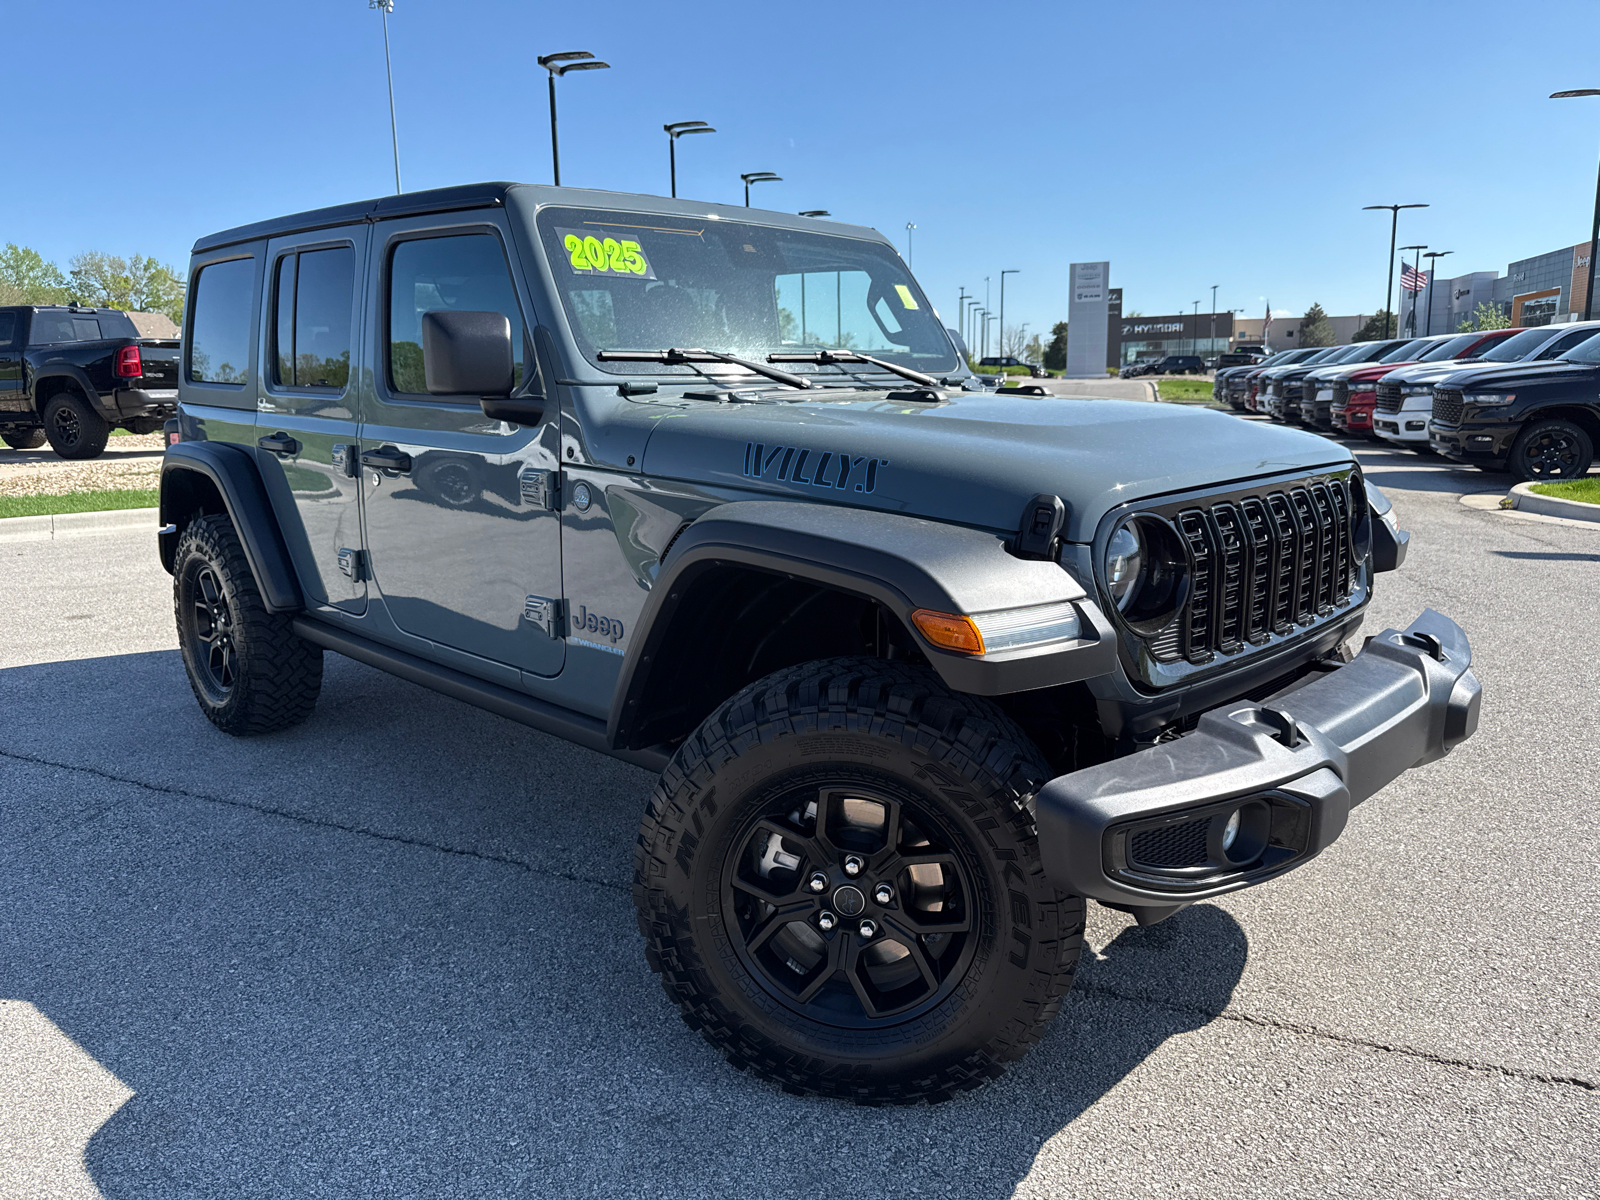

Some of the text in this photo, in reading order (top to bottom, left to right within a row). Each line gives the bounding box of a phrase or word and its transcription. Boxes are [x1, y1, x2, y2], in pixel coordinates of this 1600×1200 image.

[564, 234, 648, 275] 2025
[1574, 255, 1591, 268] Jeep
[1134, 322, 1184, 334] HYUNDAI
[1433, 391, 1449, 401] RAM
[743, 442, 890, 494] WILLYS
[572, 605, 624, 643] Jeep
[579, 638, 625, 657] WRANGLER
[910, 760, 1033, 971] FALKEN
